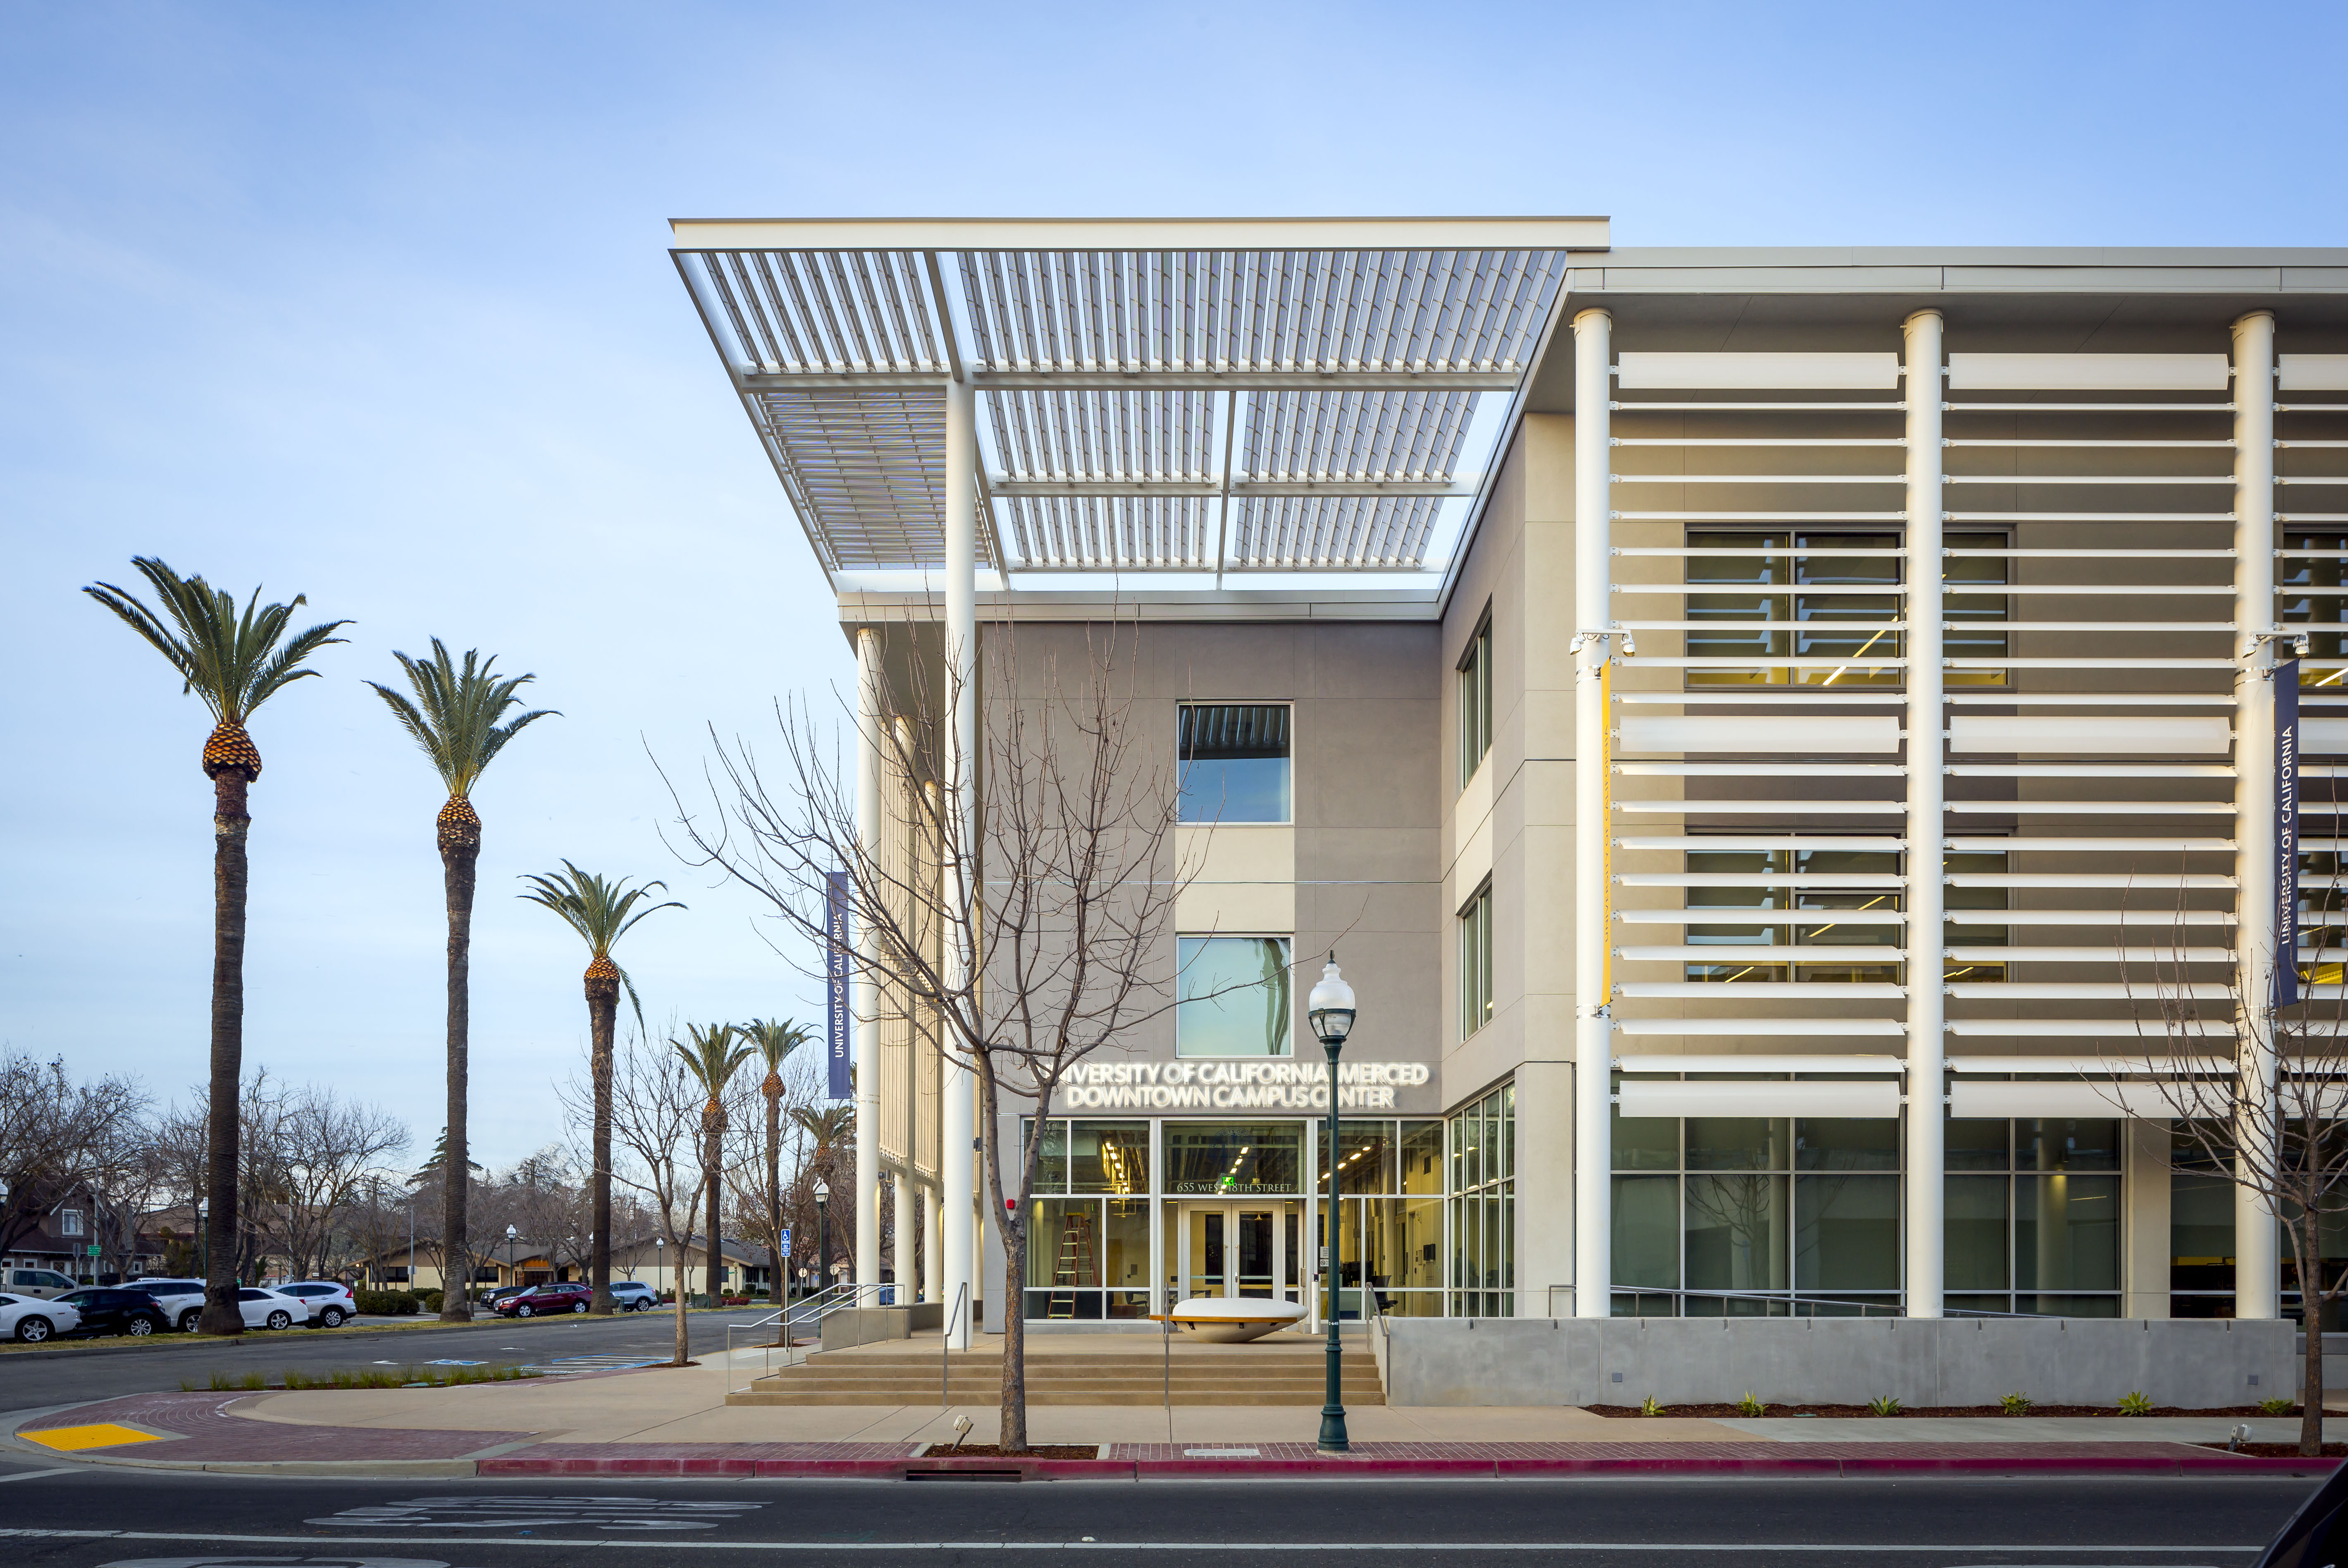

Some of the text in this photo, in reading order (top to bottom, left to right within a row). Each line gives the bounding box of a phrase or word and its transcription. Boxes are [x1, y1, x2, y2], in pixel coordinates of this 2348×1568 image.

[1605, 827, 1608, 847] OF
[2281, 725, 2292, 945] UNIVERSITY OF CALIFORNIA
[834, 979, 843, 994] OF
[834, 996, 844, 1058] UNIVERSITY
[1164, 1063, 1196, 1084] OF
[1198, 1063, 1330, 1084] CALIFORNIA
[1338, 1063, 1430, 1085] MERCED
[1067, 1086, 1396, 1107] DOWNTOWN CAMPUS CNTER
[1177, 1182, 1194, 1192] 655
[1228, 1182, 1252, 1192] 18TH
[1256, 1184, 1291, 1192] STREET
[303, 1496, 775, 1530] STOP
